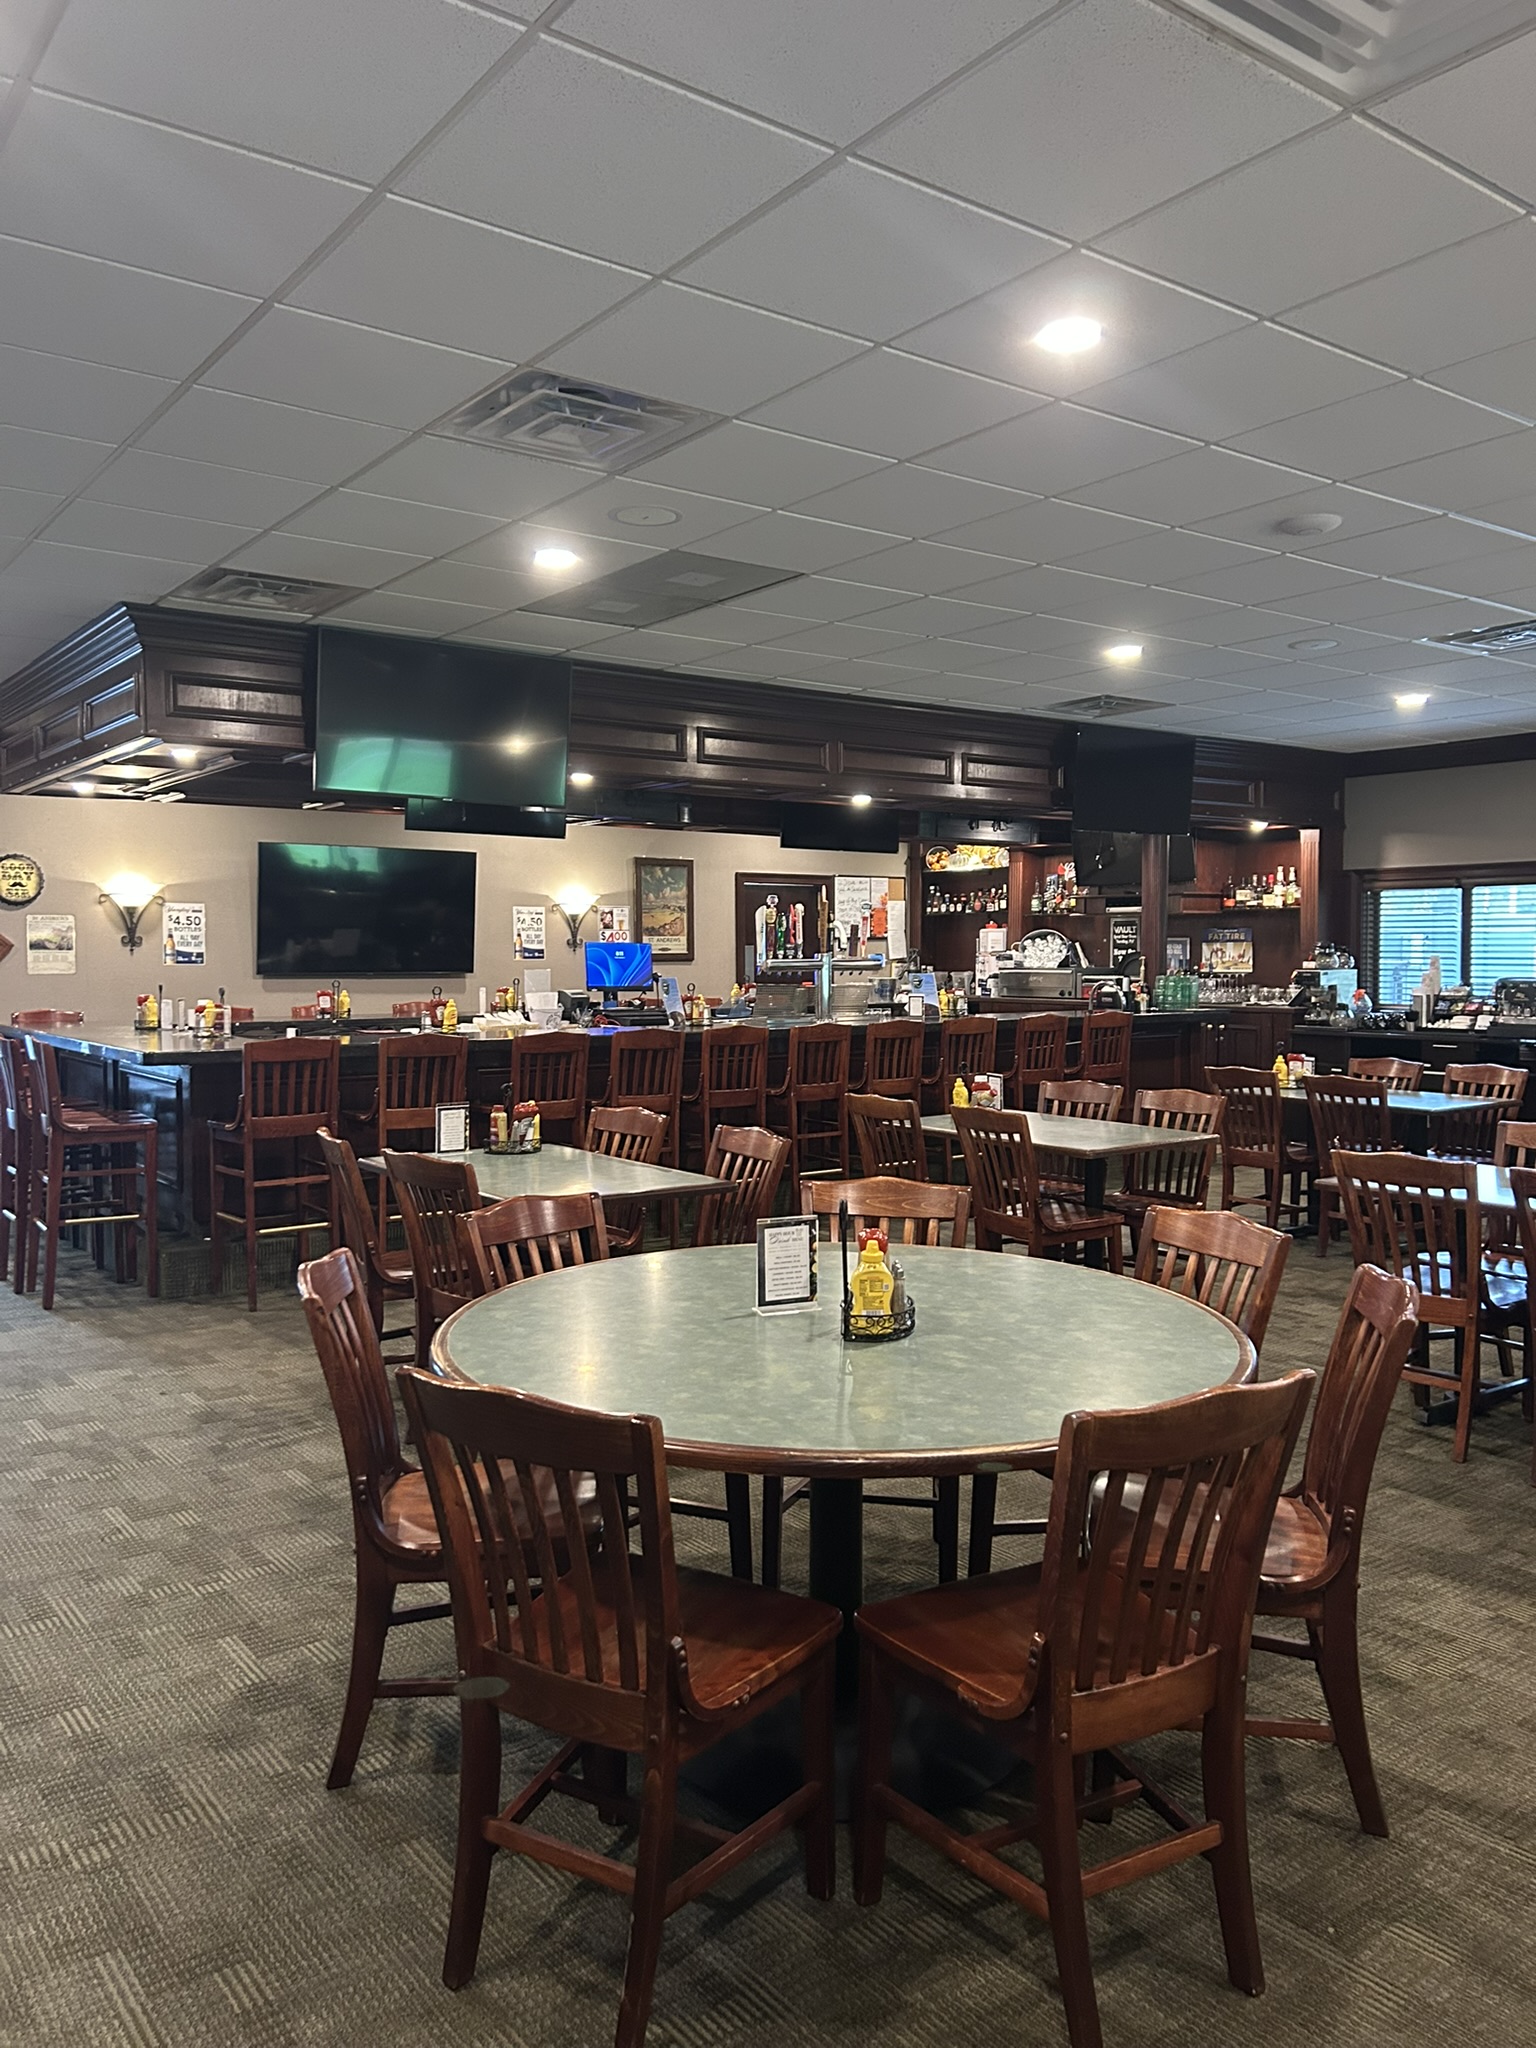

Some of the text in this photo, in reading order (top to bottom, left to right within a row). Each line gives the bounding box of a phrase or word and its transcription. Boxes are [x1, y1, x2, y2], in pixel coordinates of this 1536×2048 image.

[1, 862, 34, 870] GOOD
[1, 871, 34, 880] DAY
[168, 914, 202, 926] $4.50
[1113, 926, 1137, 934] VAULT
